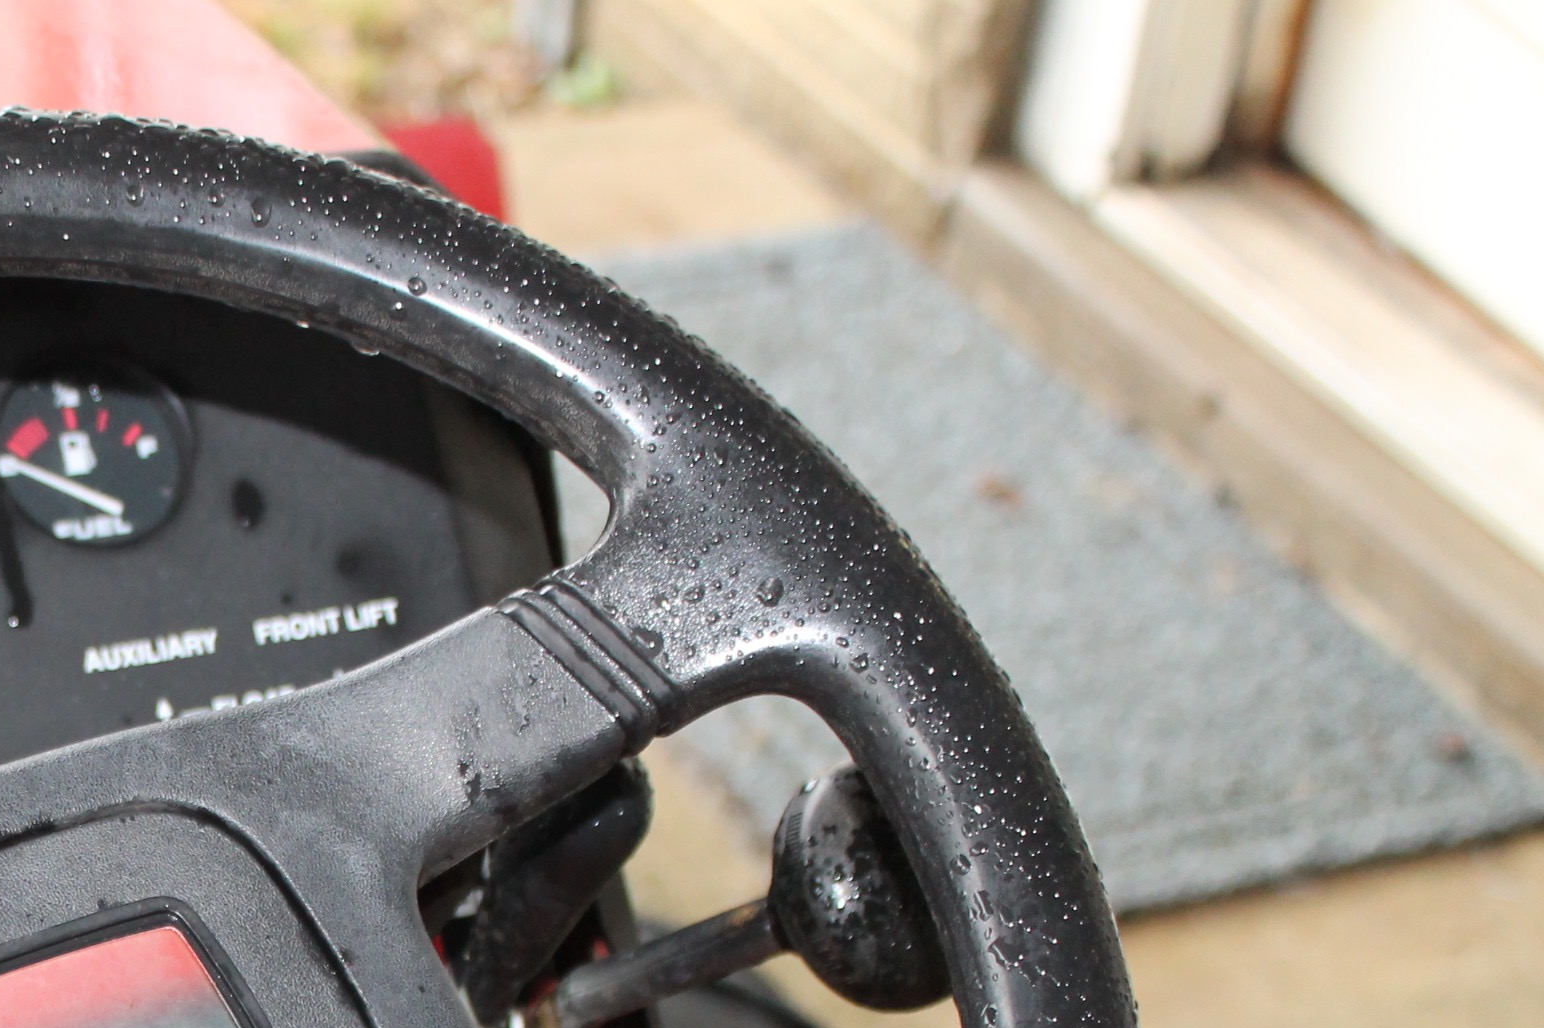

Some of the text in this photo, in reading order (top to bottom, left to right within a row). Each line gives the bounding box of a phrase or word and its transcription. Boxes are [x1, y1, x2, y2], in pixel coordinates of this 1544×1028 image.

[53, 515, 133, 540] FUEL
[254, 597, 399, 646] FRONT LIFT
[83, 629, 218, 673] AUXILIARY
